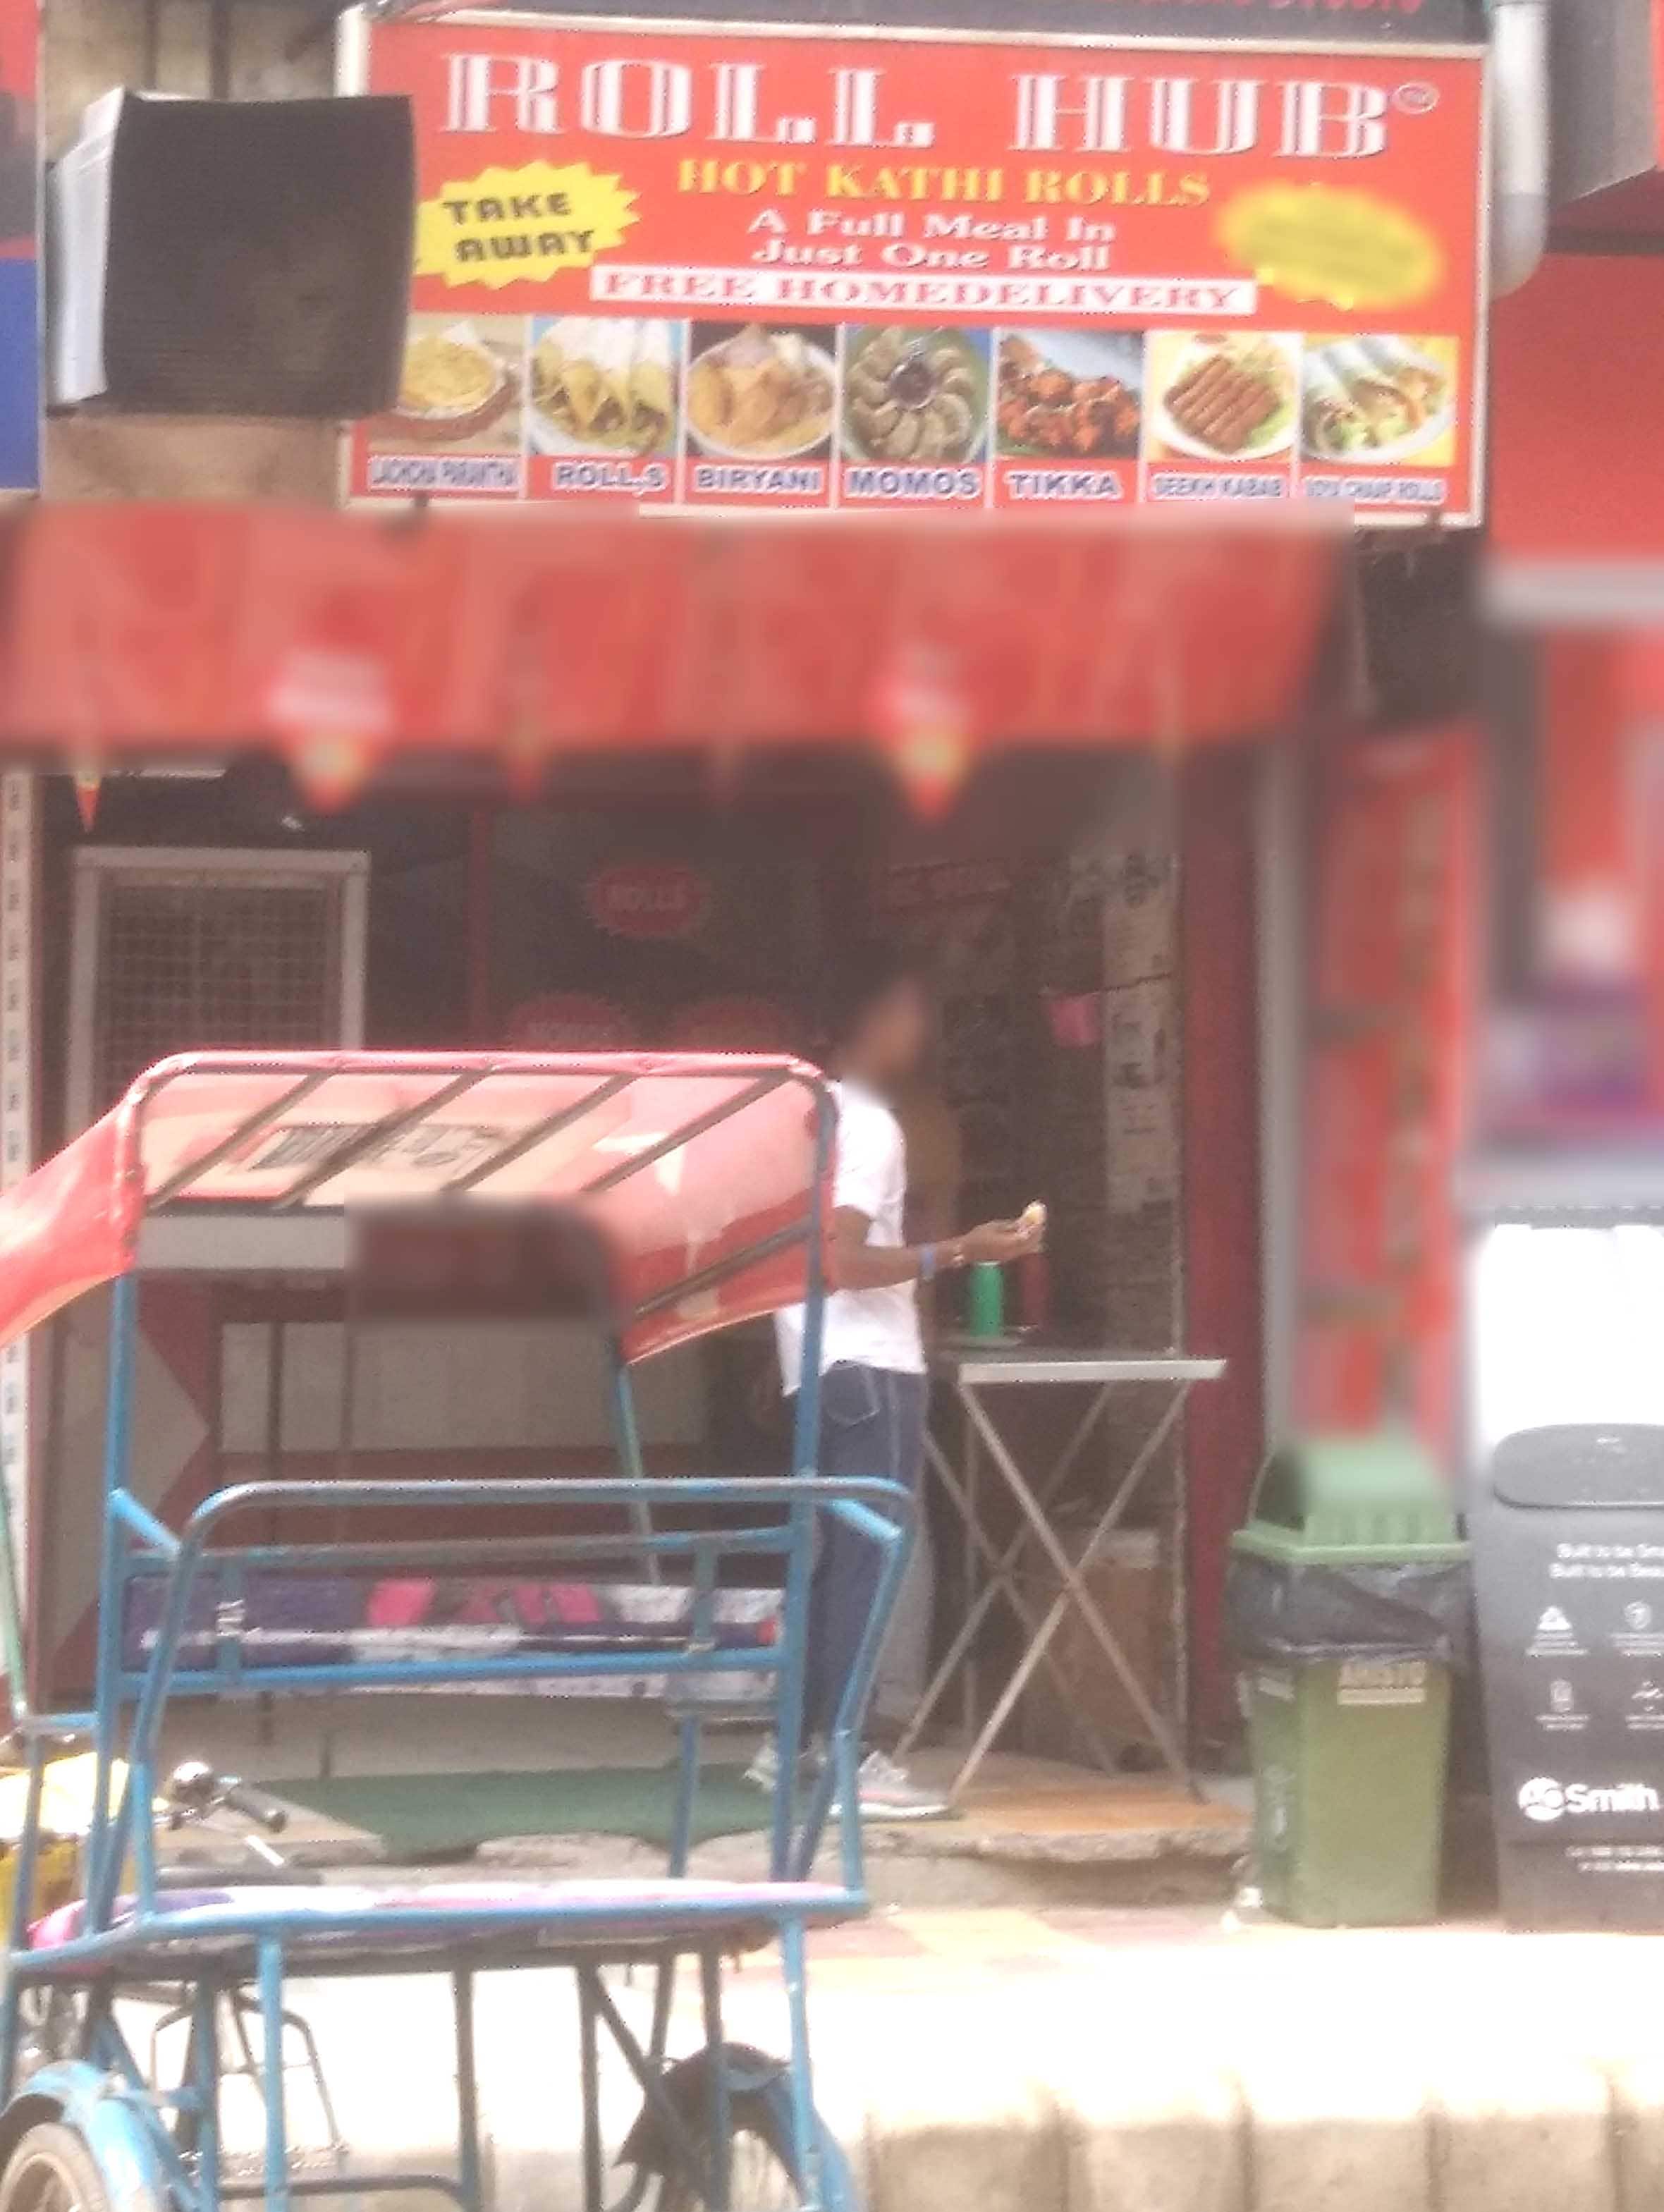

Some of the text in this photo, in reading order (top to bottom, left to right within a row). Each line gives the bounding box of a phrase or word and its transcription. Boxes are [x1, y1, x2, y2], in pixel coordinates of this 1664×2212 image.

[440, 53, 936, 149] ROLL
[678, 159, 1211, 207] HOT KATHI ROLLS
[441, 192, 573, 227] TAKE
[747, 208, 1116, 243] A Full Meal In
[455, 228, 595, 264] AWAY
[752, 239, 1111, 271] Just One Roll
[604, 271, 755, 300] FREE
[697, 466, 821, 494] BIRYANI
[848, 468, 980, 497] MOMOS
[1008, 471, 1124, 499] TIKKA
